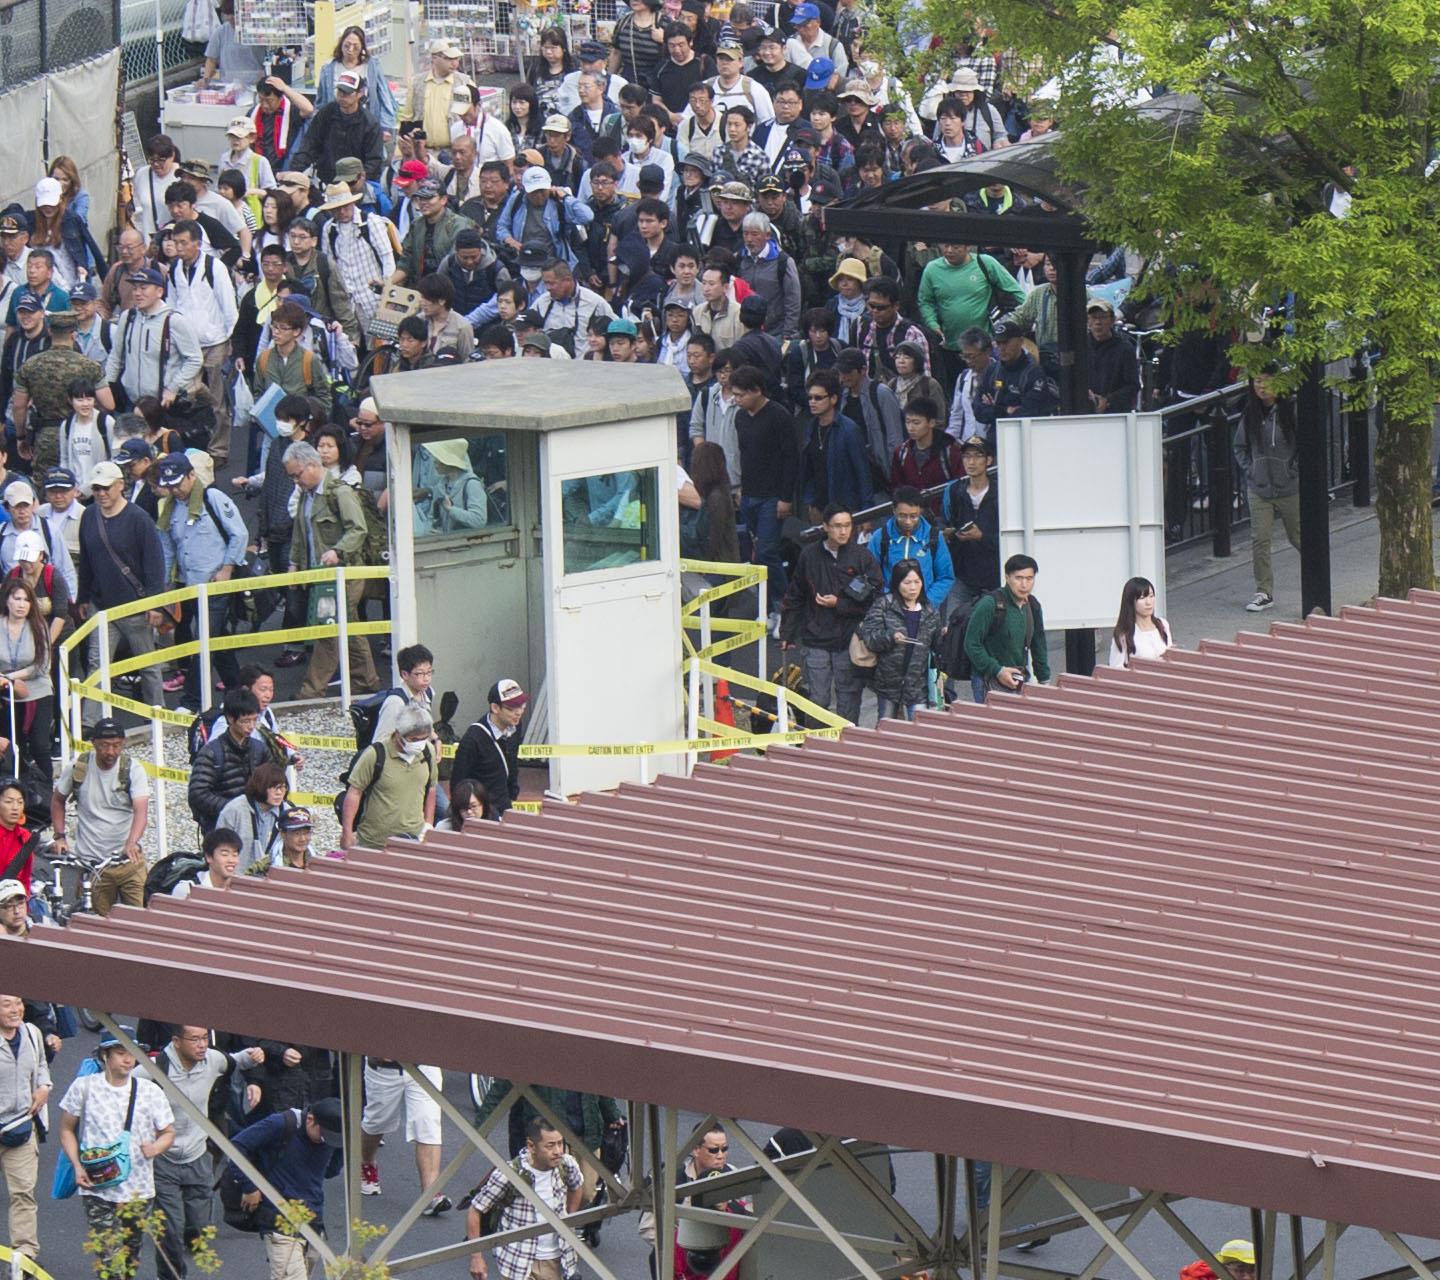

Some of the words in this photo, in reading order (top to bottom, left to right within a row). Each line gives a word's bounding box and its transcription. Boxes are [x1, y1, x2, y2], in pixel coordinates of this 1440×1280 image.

[299, 736, 320, 746] CAUTION
[322, 737, 329, 746] DO
[331, 737, 341, 747] NOT
[688, 740, 710, 749] CAUTION
[712, 739, 720, 748] DO
[721, 738, 732, 747] NOT
[734, 737, 751, 747] ENTER
[521, 747, 533, 755] NOT
[534, 747, 552, 756] ENTER
[588, 746, 610, 755] CAUTION
[613, 746, 622, 755] DO
[623, 746, 634, 754] NOT
[636, 745, 654, 754] ENTER
